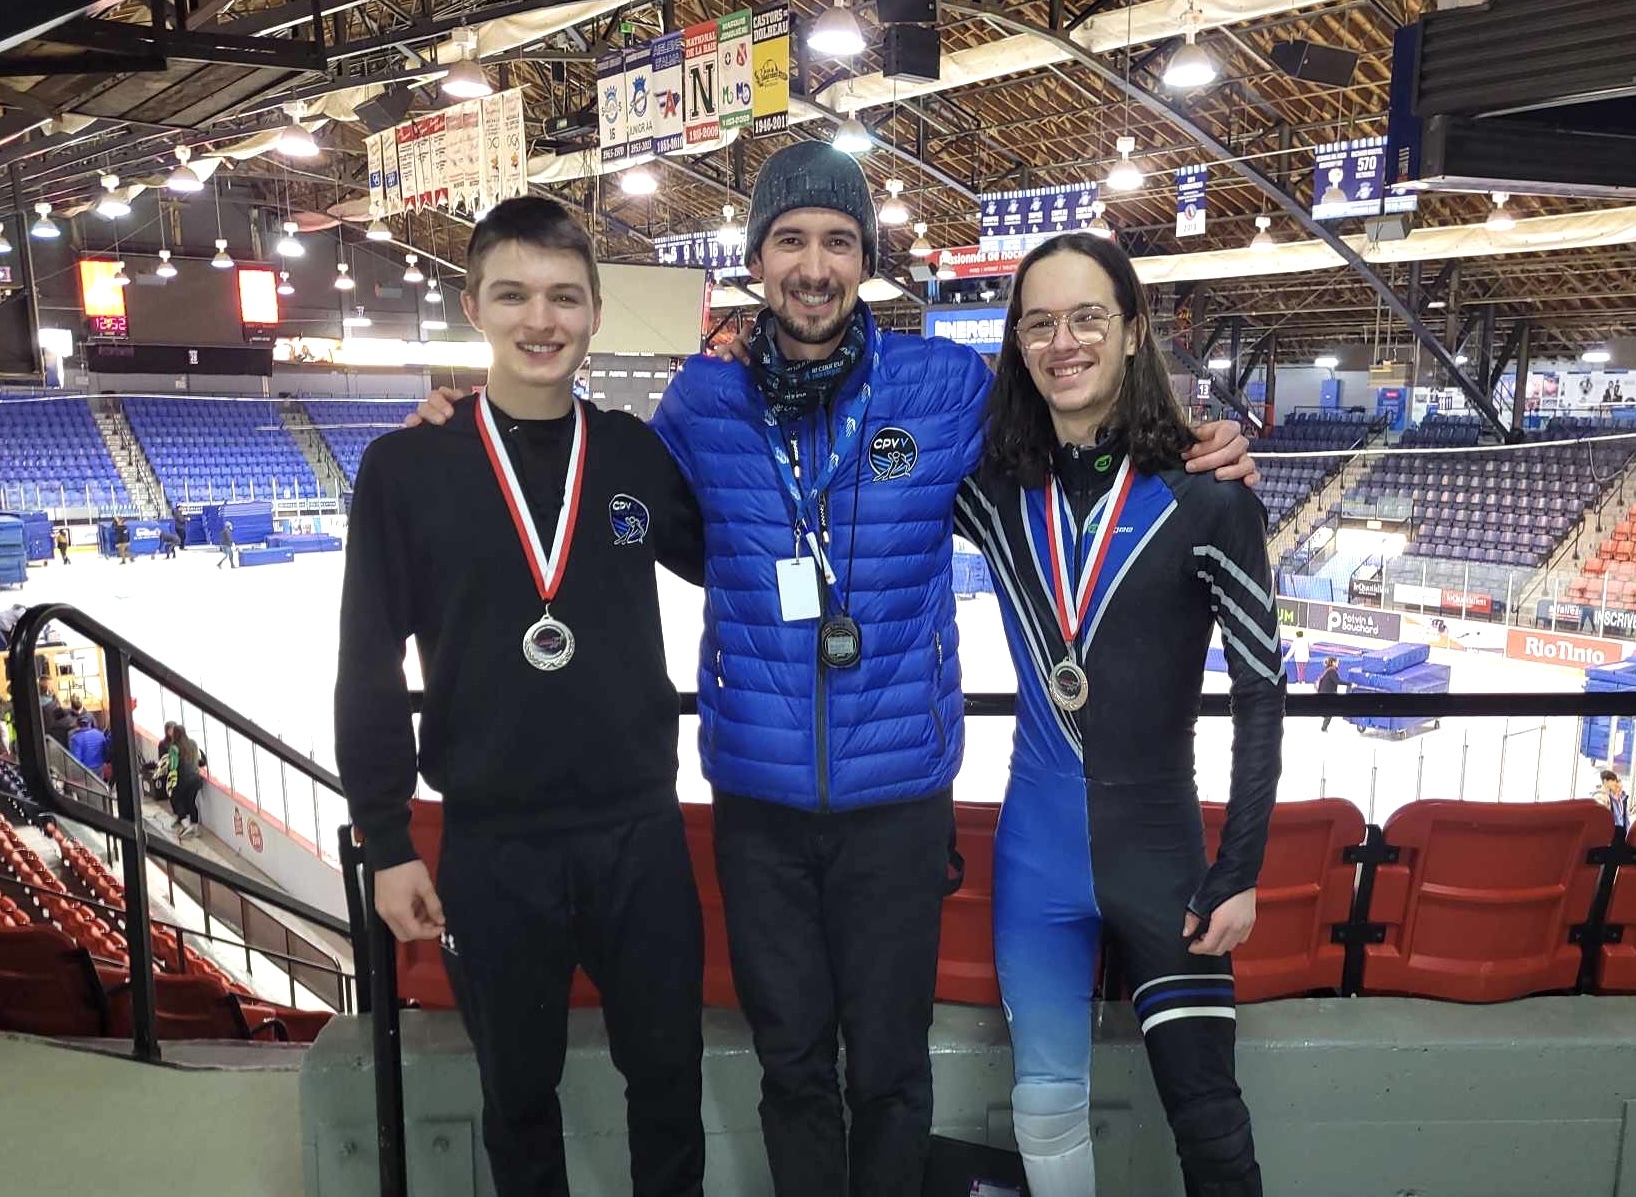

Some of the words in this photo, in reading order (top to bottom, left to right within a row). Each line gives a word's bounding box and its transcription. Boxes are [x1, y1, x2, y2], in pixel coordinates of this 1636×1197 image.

[753, 20, 788, 42] DOLBEAU
[686, 31, 716, 48] NATIONAL
[1357, 155, 1377, 171] 570
[873, 437, 909, 449] CPVV
[1342, 612, 1366, 625] Potvin
[1341, 621, 1380, 635] Bouchard
